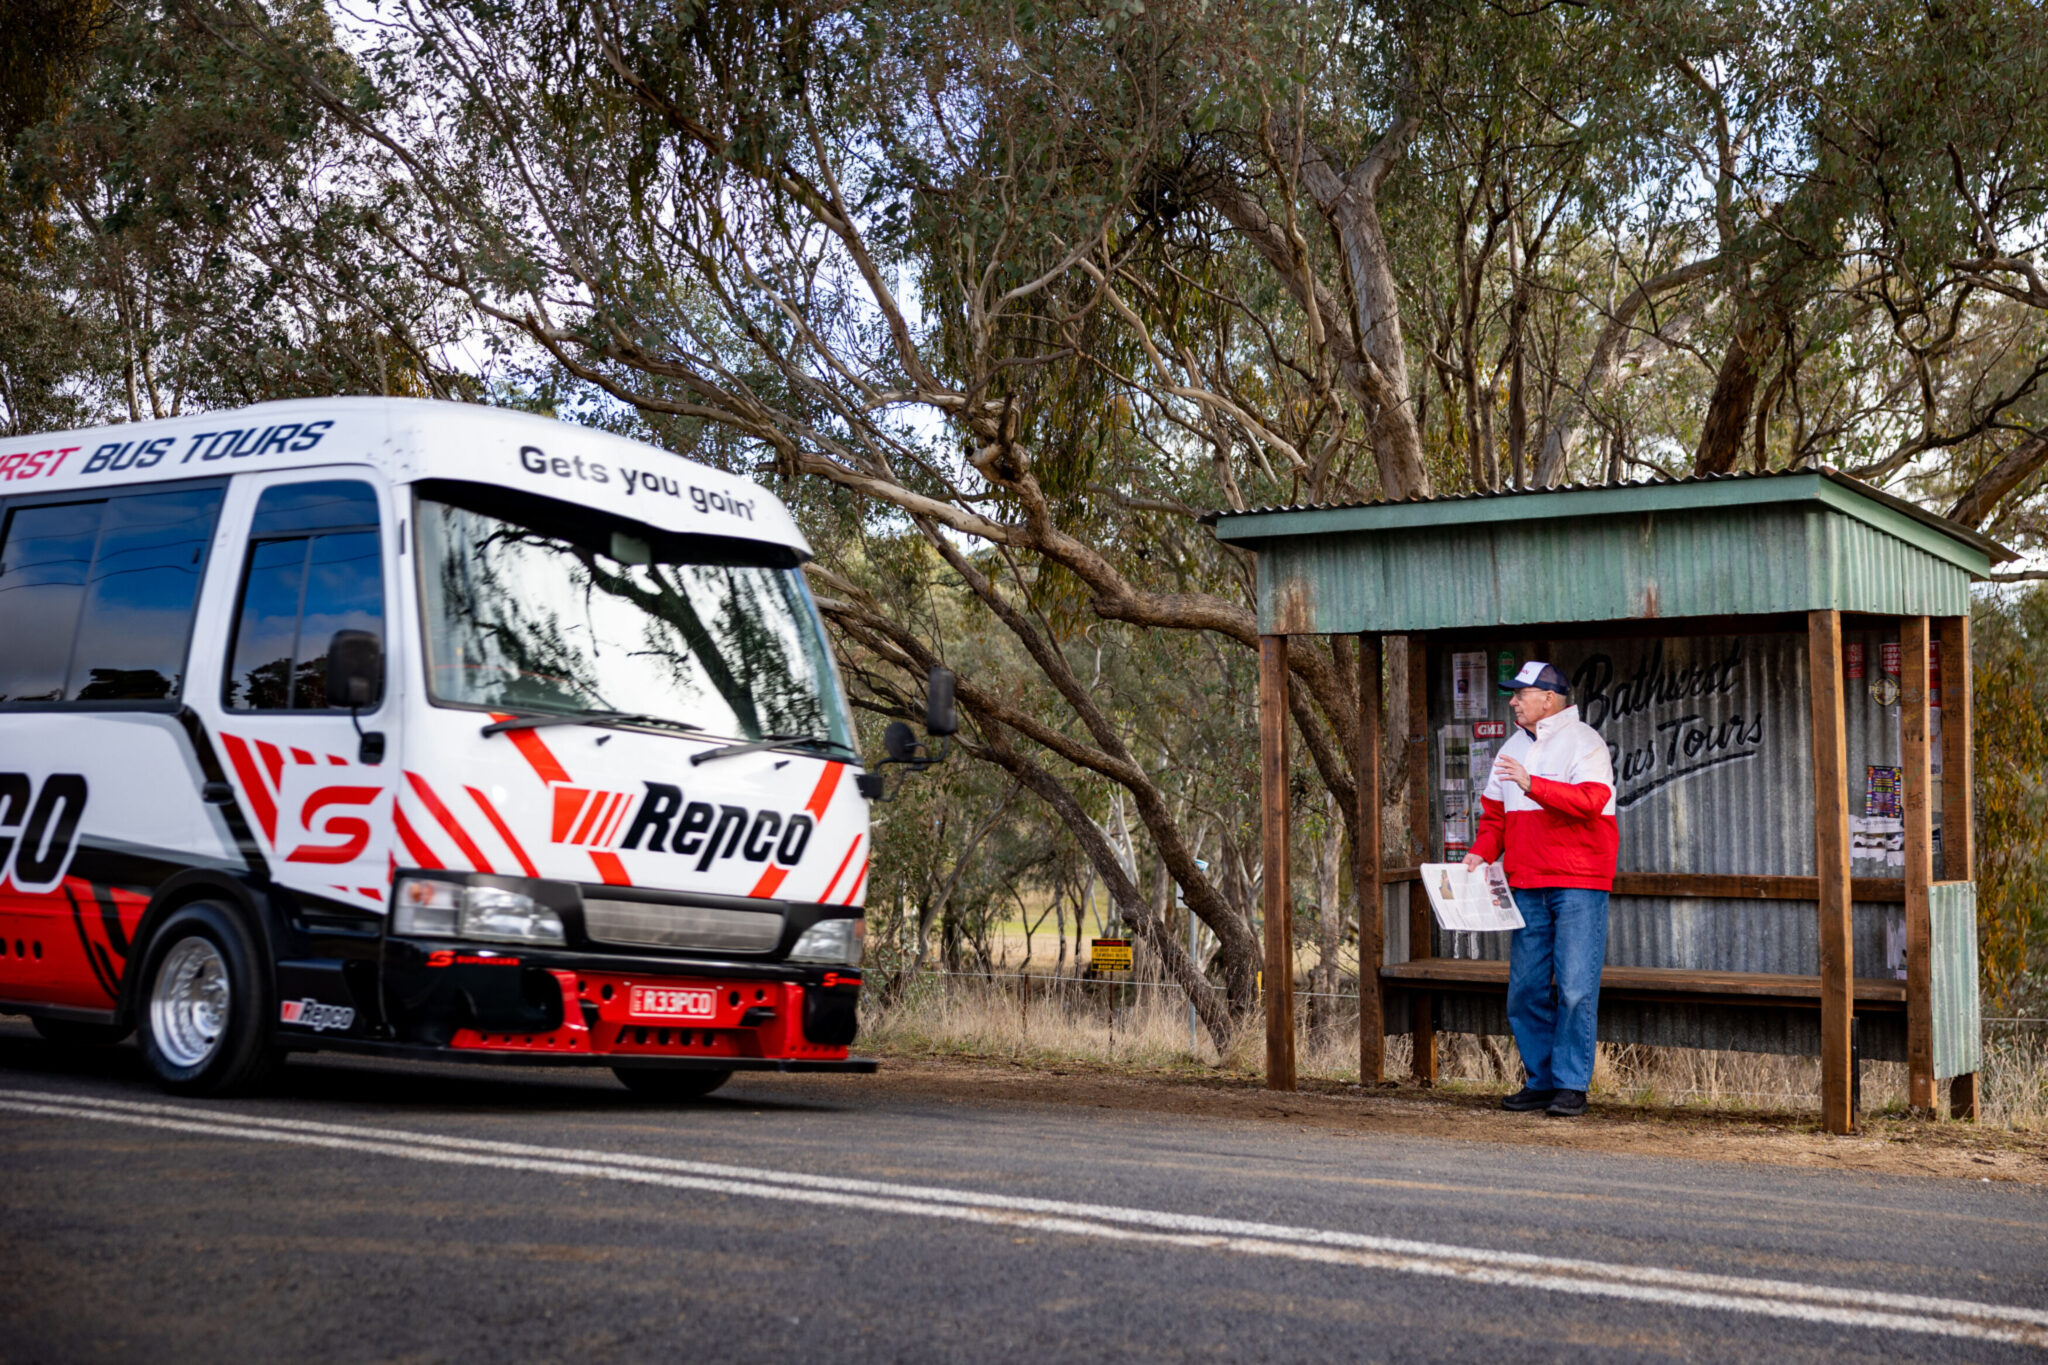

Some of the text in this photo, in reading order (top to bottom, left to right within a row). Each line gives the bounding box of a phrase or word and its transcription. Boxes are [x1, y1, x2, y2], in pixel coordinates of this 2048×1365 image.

[0, 420, 335, 481] RST BUS TOURS
[520, 445, 609, 484] Gets
[619, 467, 681, 498] you
[1657, 712, 1762, 766] Tours
[621, 781, 813, 872] Repco
[299, 998, 354, 1031] Repco
